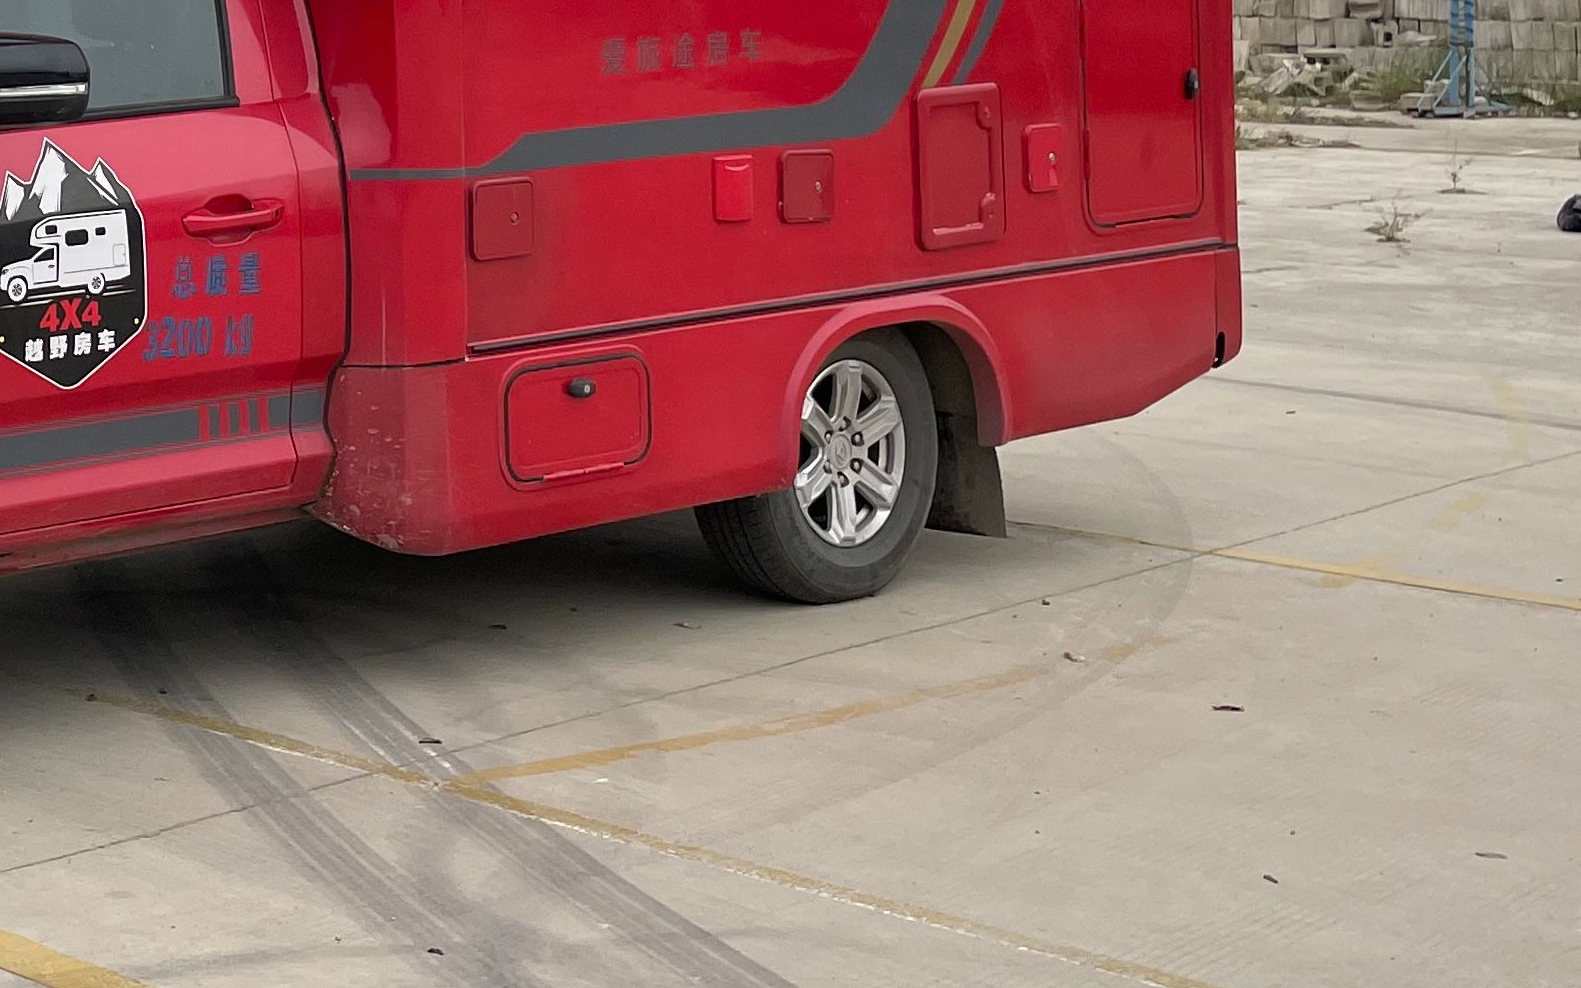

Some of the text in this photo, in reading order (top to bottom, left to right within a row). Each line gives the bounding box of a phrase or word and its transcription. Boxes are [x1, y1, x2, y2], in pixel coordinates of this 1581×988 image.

[172, 251, 261, 299] 总质量
[24, 328, 116, 362] 越野房车
[142, 315, 213, 362] 3200
